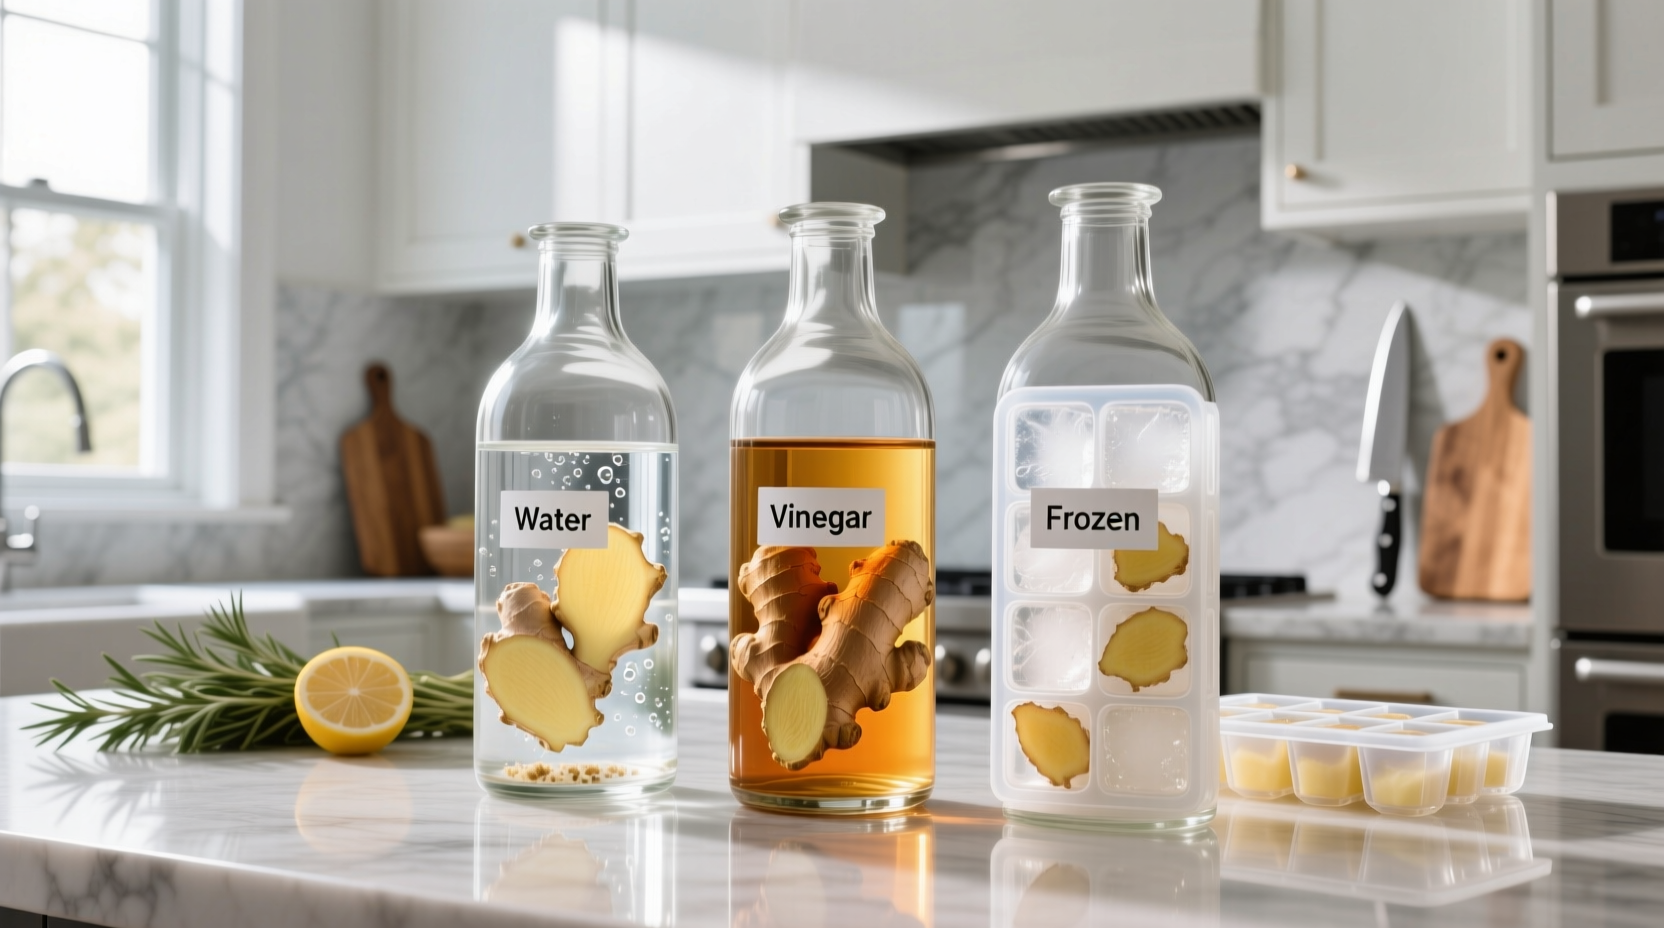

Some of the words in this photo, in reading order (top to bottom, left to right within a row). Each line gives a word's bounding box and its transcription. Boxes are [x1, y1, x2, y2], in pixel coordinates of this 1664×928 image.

[514, 506, 592, 532] Water
[769, 503, 873, 535] Vinegar
[1046, 504, 1140, 531] Frozen
